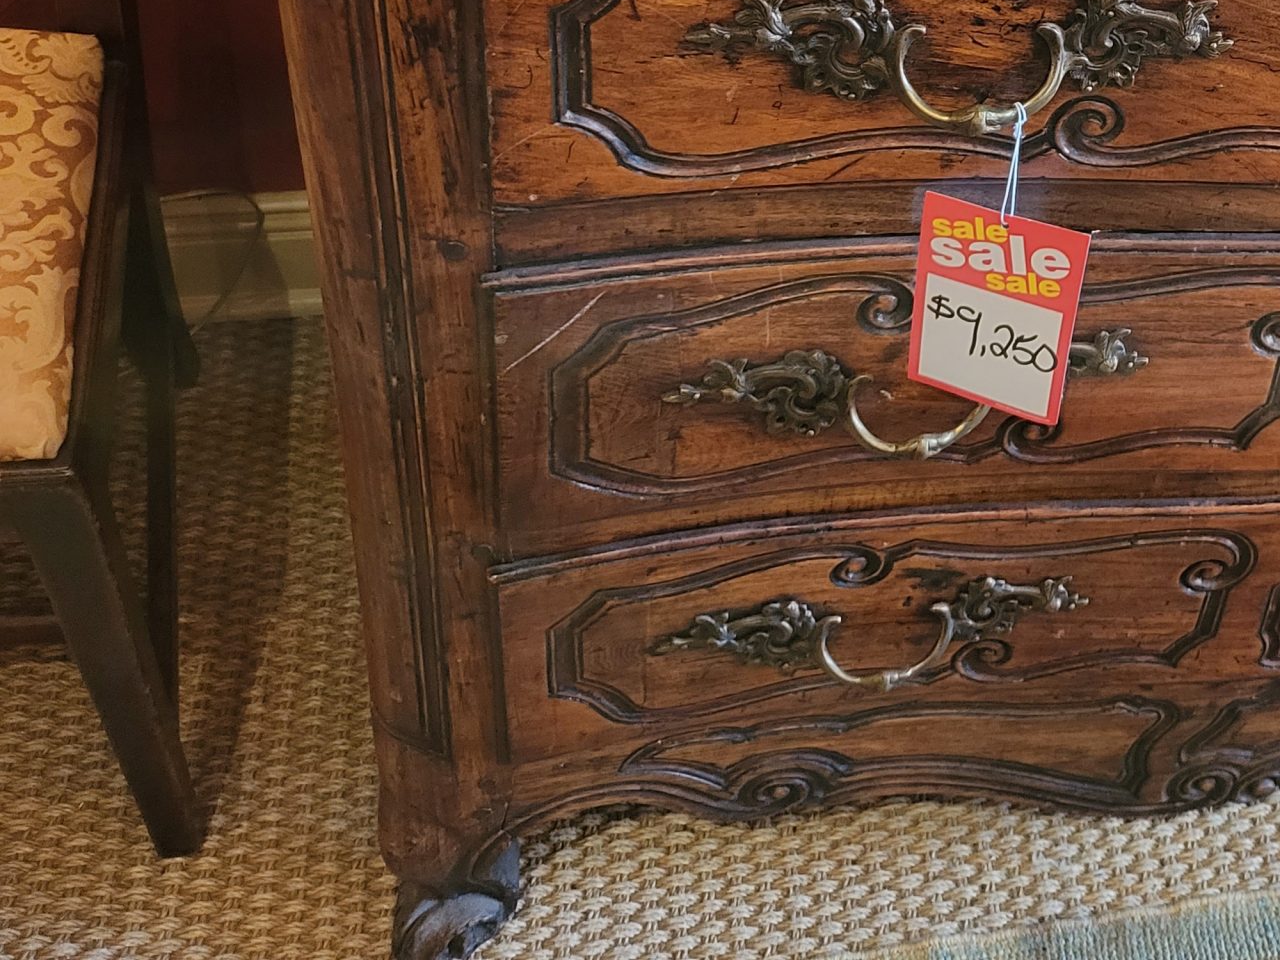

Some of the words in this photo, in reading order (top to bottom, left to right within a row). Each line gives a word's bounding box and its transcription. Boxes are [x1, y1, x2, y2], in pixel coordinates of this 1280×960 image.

[931, 217, 1008, 243] sale
[930, 234, 1071, 280] sale
[985, 272, 1061, 298] sale
[926, 295, 1058, 372] $9,250
